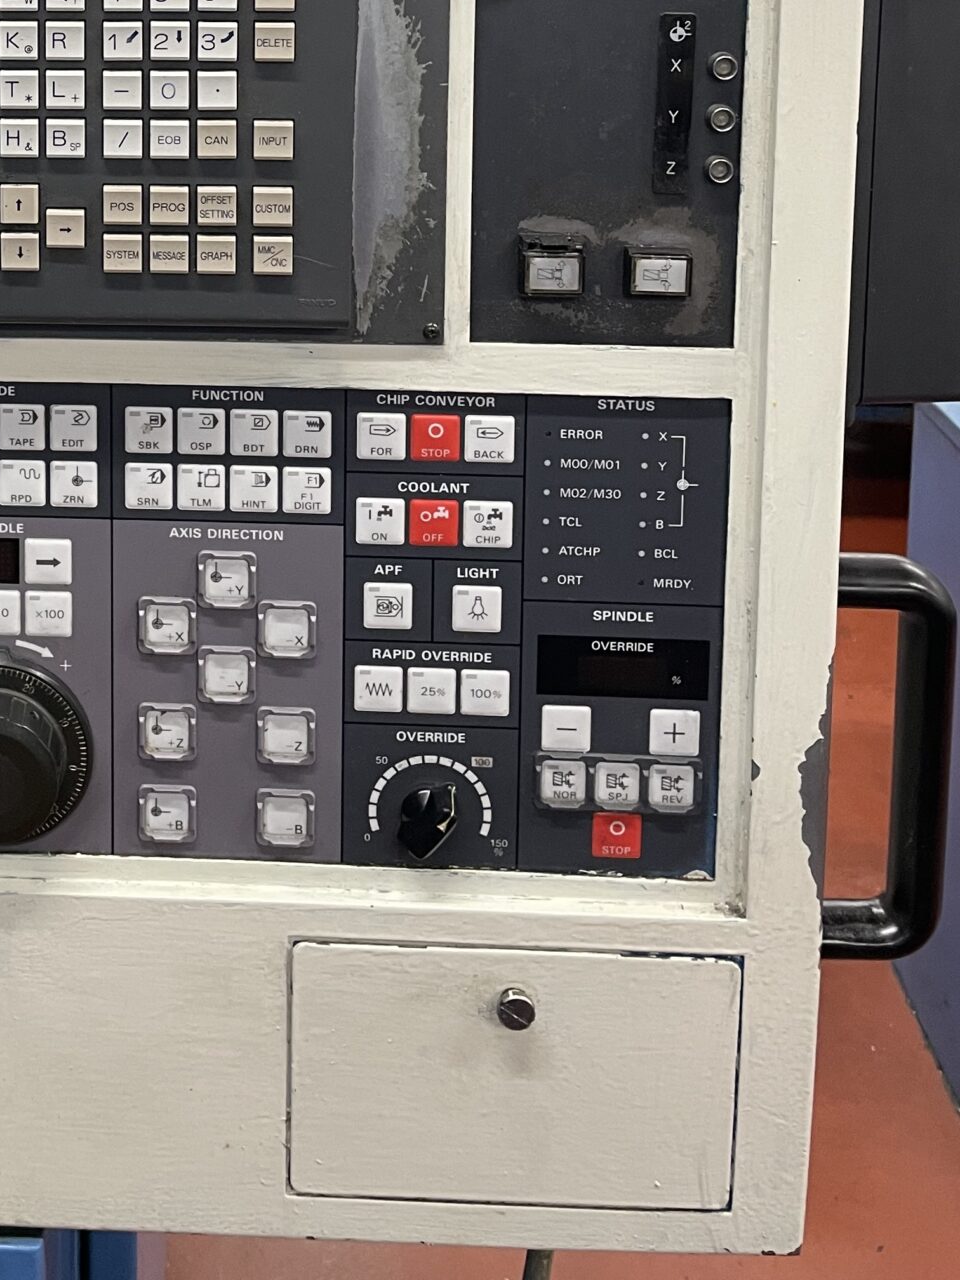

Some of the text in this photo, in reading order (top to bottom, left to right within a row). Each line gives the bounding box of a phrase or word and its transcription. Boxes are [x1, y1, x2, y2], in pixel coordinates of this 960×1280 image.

[257, 39, 292, 48] DELETE
[158, 135, 181, 145] EOB
[205, 135, 228, 145] CAN
[259, 136, 287, 146] INPUT
[201, 196, 232, 205] OFFSET
[110, 203, 134, 211] POS
[153, 203, 185, 212] PROG
[255, 204, 290, 213] CUSTOM
[200, 210, 234, 219] SETTING
[106, 250, 139, 259] SYSTEM
[153, 252, 186, 260] MESSAGE
[200, 252, 232, 261] GRAPH
[192, 390, 264, 402] FUNCTION
[377, 394, 495, 407] CHIP CONVEYOR
[598, 399, 655, 411] STATUS
[560, 429, 603, 440] ERROR
[10, 438, 35, 447] TAPE
[62, 439, 84, 447] EDIT
[138, 441, 159, 450] SBK
[190, 442, 212, 451] OSP
[243, 444, 265, 452] BDT
[295, 445, 318, 454] DRN
[421, 449, 450, 458] STOP
[474, 450, 504, 459] BACK
[560, 459, 620, 470] M00/M01
[398, 482, 470, 494] COOLANT
[560, 488, 621, 499] M02/M30
[11, 495, 32, 503] RPD
[63, 495, 84, 504] ZRN
[137, 498, 159, 506] SRN
[190, 499, 211, 507] TLM
[242, 500, 266, 509] HINT
[294, 502, 321, 510] DIGIT
[559, 517, 582, 527] TCL
[169, 528, 284, 541] AXIS DIRECTION
[372, 533, 387, 541] ON
[423, 534, 444, 542] OFF
[475, 536, 501, 544] CHIP
[559, 546, 601, 557] ATCHP
[654, 549, 678, 559] BCL
[374, 565, 402, 575] APF
[457, 568, 499, 579] LIGHT
[557, 575, 583, 585] ORT
[654, 579, 691, 589] MRDY
[593, 610, 654, 622] SPINDLE
[591, 641, 654, 652] OVERRIDE
[372, 649, 492, 662] RAPID OVERRIDE
[396, 731, 466, 743] OVERRIDE
[553, 791, 576, 799] NOR
[662, 795, 683, 803] REV
[602, 846, 631, 854] STOP
